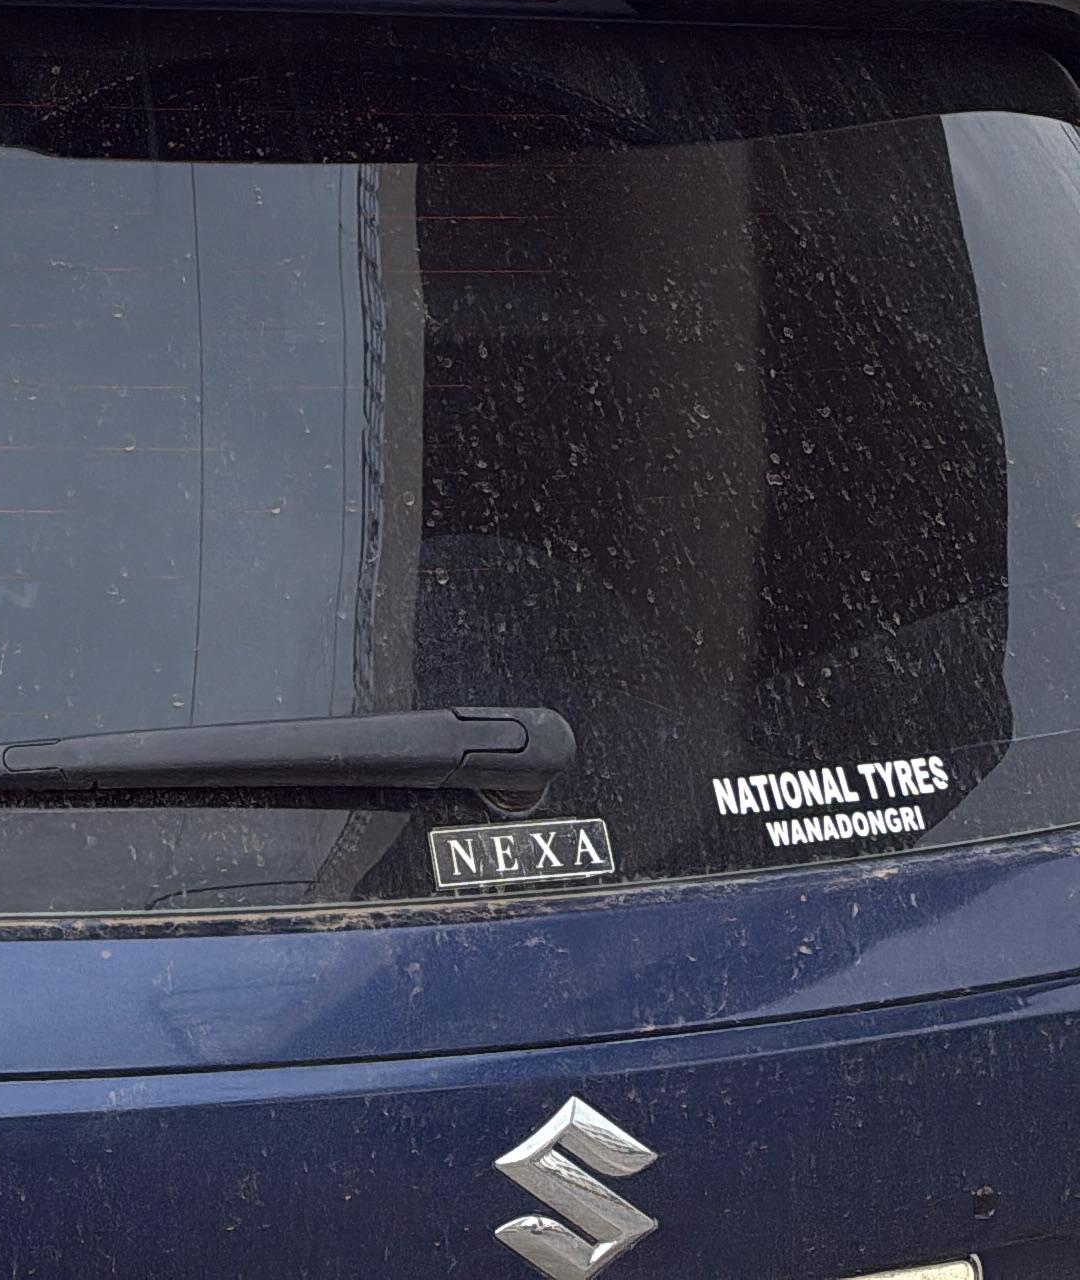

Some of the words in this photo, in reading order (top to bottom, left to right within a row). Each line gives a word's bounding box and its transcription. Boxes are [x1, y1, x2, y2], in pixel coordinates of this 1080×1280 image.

[712, 767, 860, 815] NATIONAL
[857, 755, 950, 799] TYRES
[766, 805, 926, 848] WANADONGRI
[450, 828, 605, 876] NEXA
